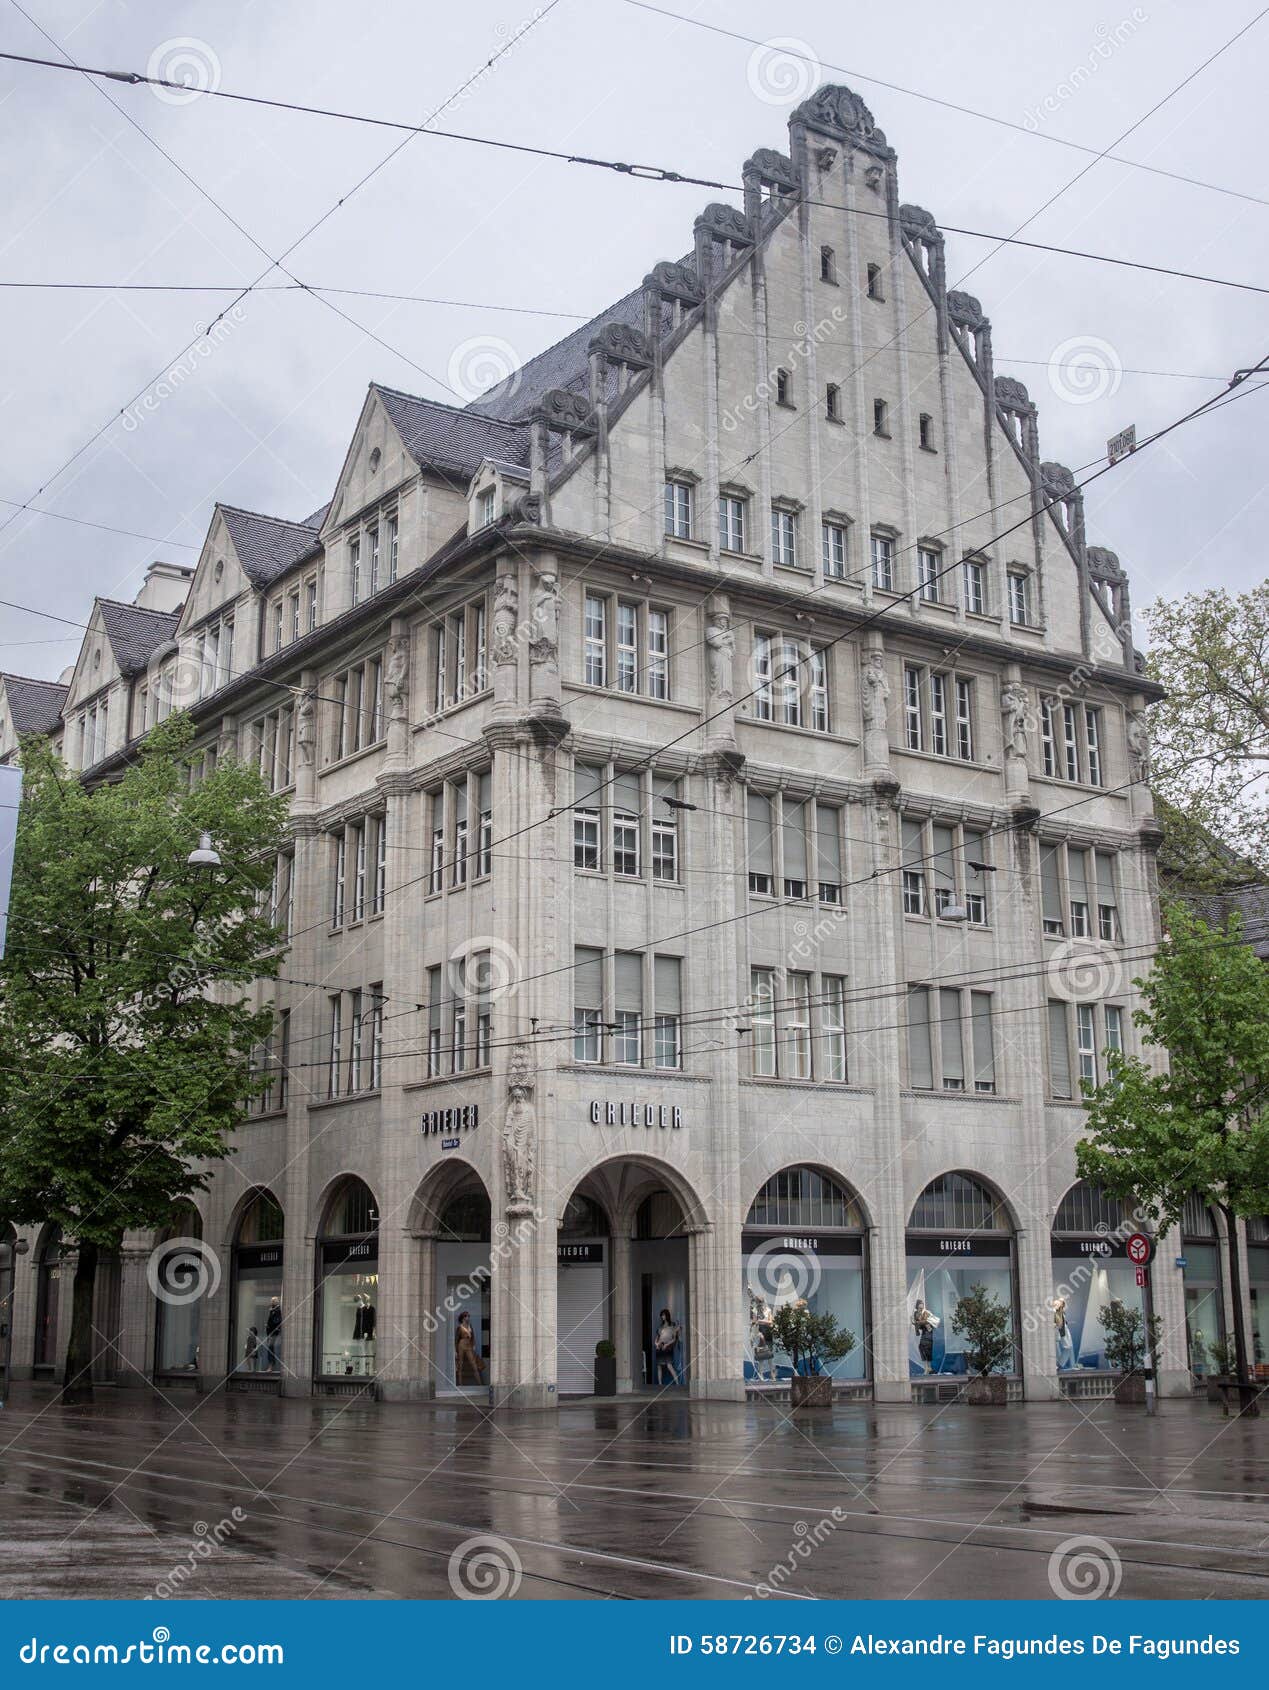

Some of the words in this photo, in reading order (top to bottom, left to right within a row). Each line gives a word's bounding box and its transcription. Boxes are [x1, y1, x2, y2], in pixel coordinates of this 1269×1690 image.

[420, 1105, 478, 1134] GRIEDER
[591, 1101, 682, 1128] GRIEDER
[783, 1238, 818, 1249] GRIEDER
[940, 1241, 971, 1250] GRIEDER
[557, 1246, 589, 1256] RIEDER
